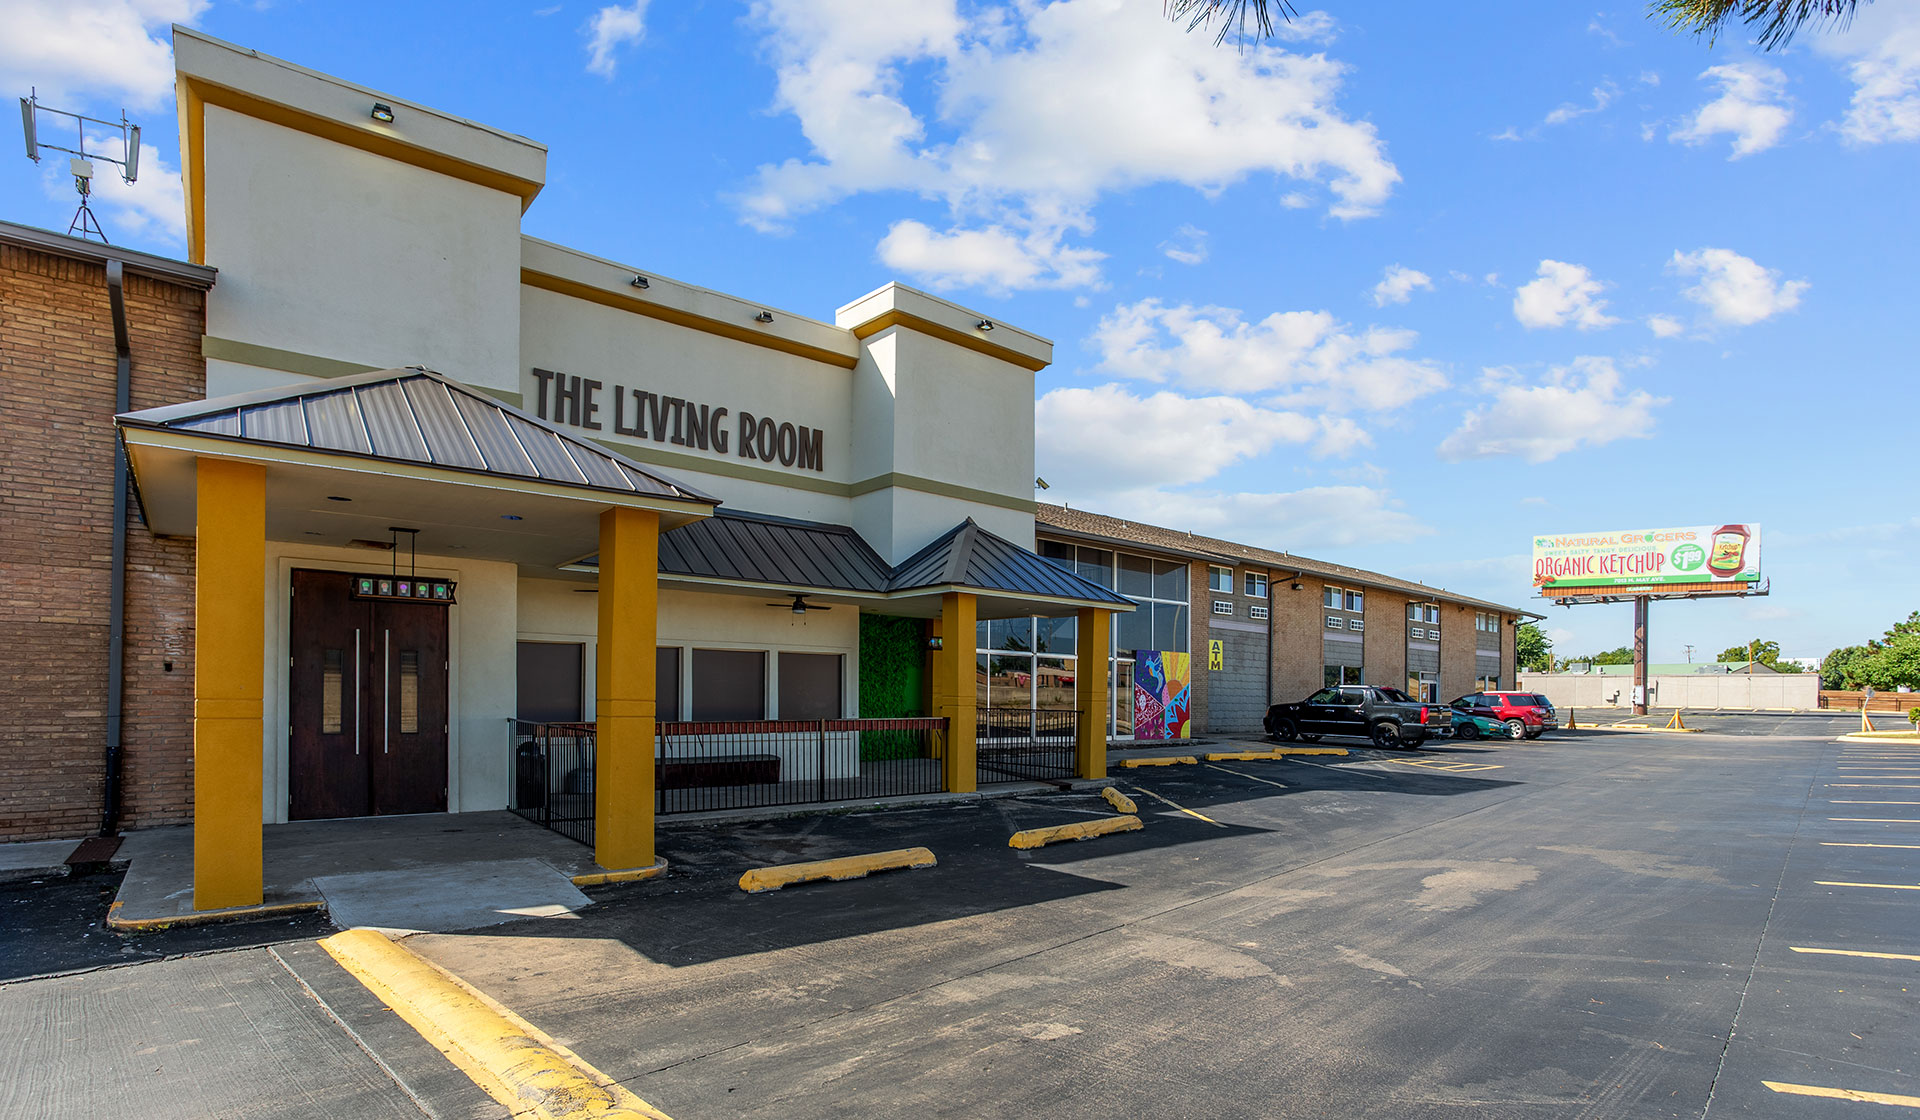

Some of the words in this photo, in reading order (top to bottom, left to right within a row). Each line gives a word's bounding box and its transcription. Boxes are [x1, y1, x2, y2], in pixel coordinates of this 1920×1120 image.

[533, 367, 602, 431] THE
[615, 385, 728, 453] LIVING
[739, 411, 824, 472] ROOM
[1555, 537, 1618, 548] NATURAL
[1621, 531, 1697, 544] GROCERS
[1535, 556, 1594, 577] ORGANIC
[1600, 552, 1665, 575] KETCHUP
[1211, 641, 1220, 670] ATM
